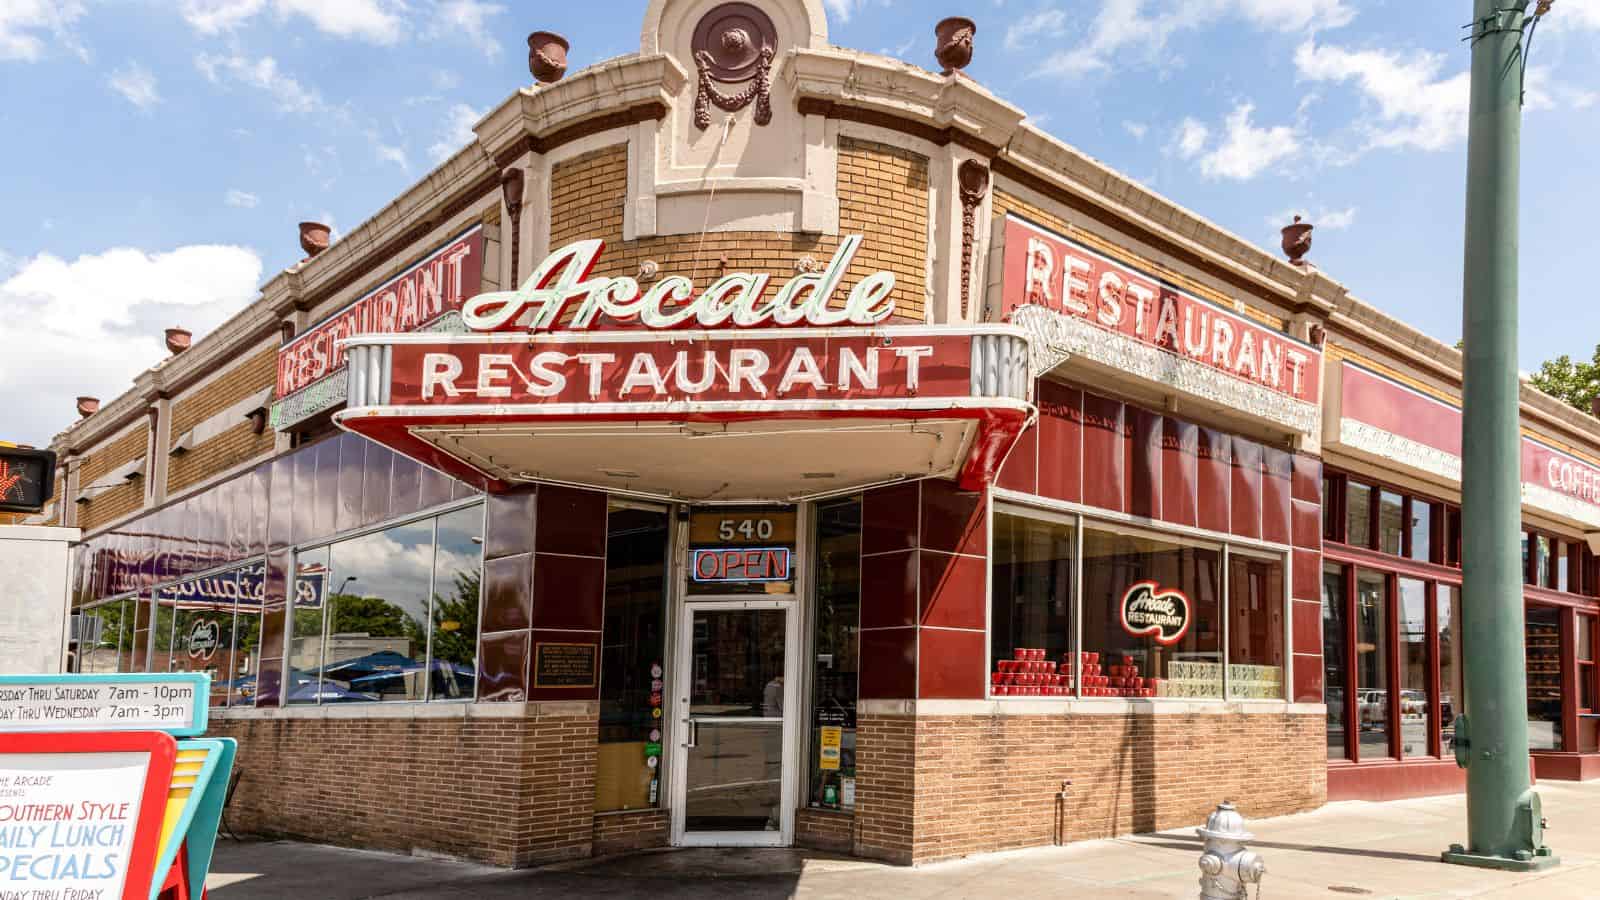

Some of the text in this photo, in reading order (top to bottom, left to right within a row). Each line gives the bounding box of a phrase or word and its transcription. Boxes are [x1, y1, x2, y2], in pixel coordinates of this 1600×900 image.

[462, 234, 897, 330] Arcade
[1024, 237, 1310, 397] RESTAURANT
[421, 345, 933, 401] RESTAURANT
[719, 519, 773, 541] 540
[697, 550, 787, 579] OPEN
[1129, 590, 1176, 616] Arcade
[1127, 611, 1183, 627] RESTAURANT
[109, 686, 139, 700] 7am
[153, 685, 192, 702] 10pm
[109, 705, 140, 718] 7am
[152, 703, 184, 720] 3pm
[77, 800, 130, 820] STYLE
[50, 821, 125, 848] LUNCH
